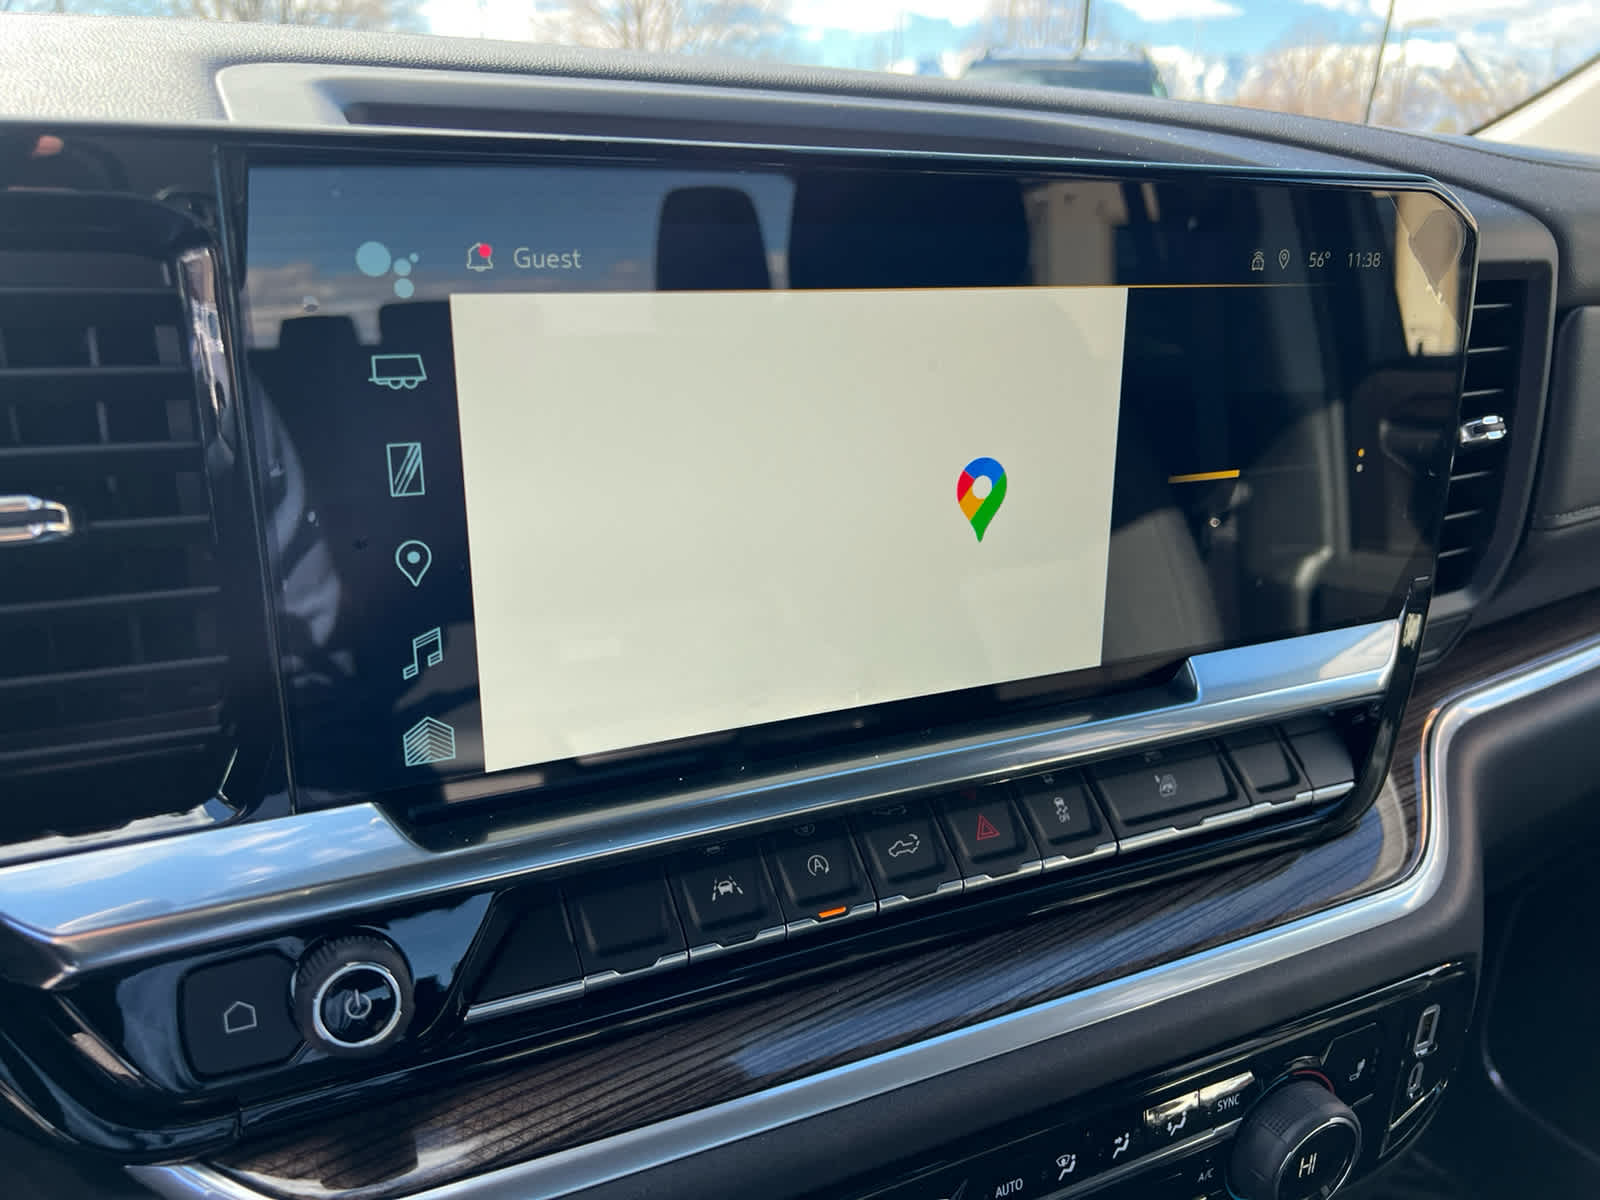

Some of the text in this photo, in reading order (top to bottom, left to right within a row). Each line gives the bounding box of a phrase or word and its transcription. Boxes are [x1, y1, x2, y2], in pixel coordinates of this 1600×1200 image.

[513, 247, 582, 269] Guest
[1347, 251, 1382, 268] 11:38
[1217, 1093, 1240, 1113] SYNC
[1197, 1167, 1215, 1183] A/C
[1298, 1152, 1318, 1178] HI
[995, 1177, 1024, 1199] AUTO
